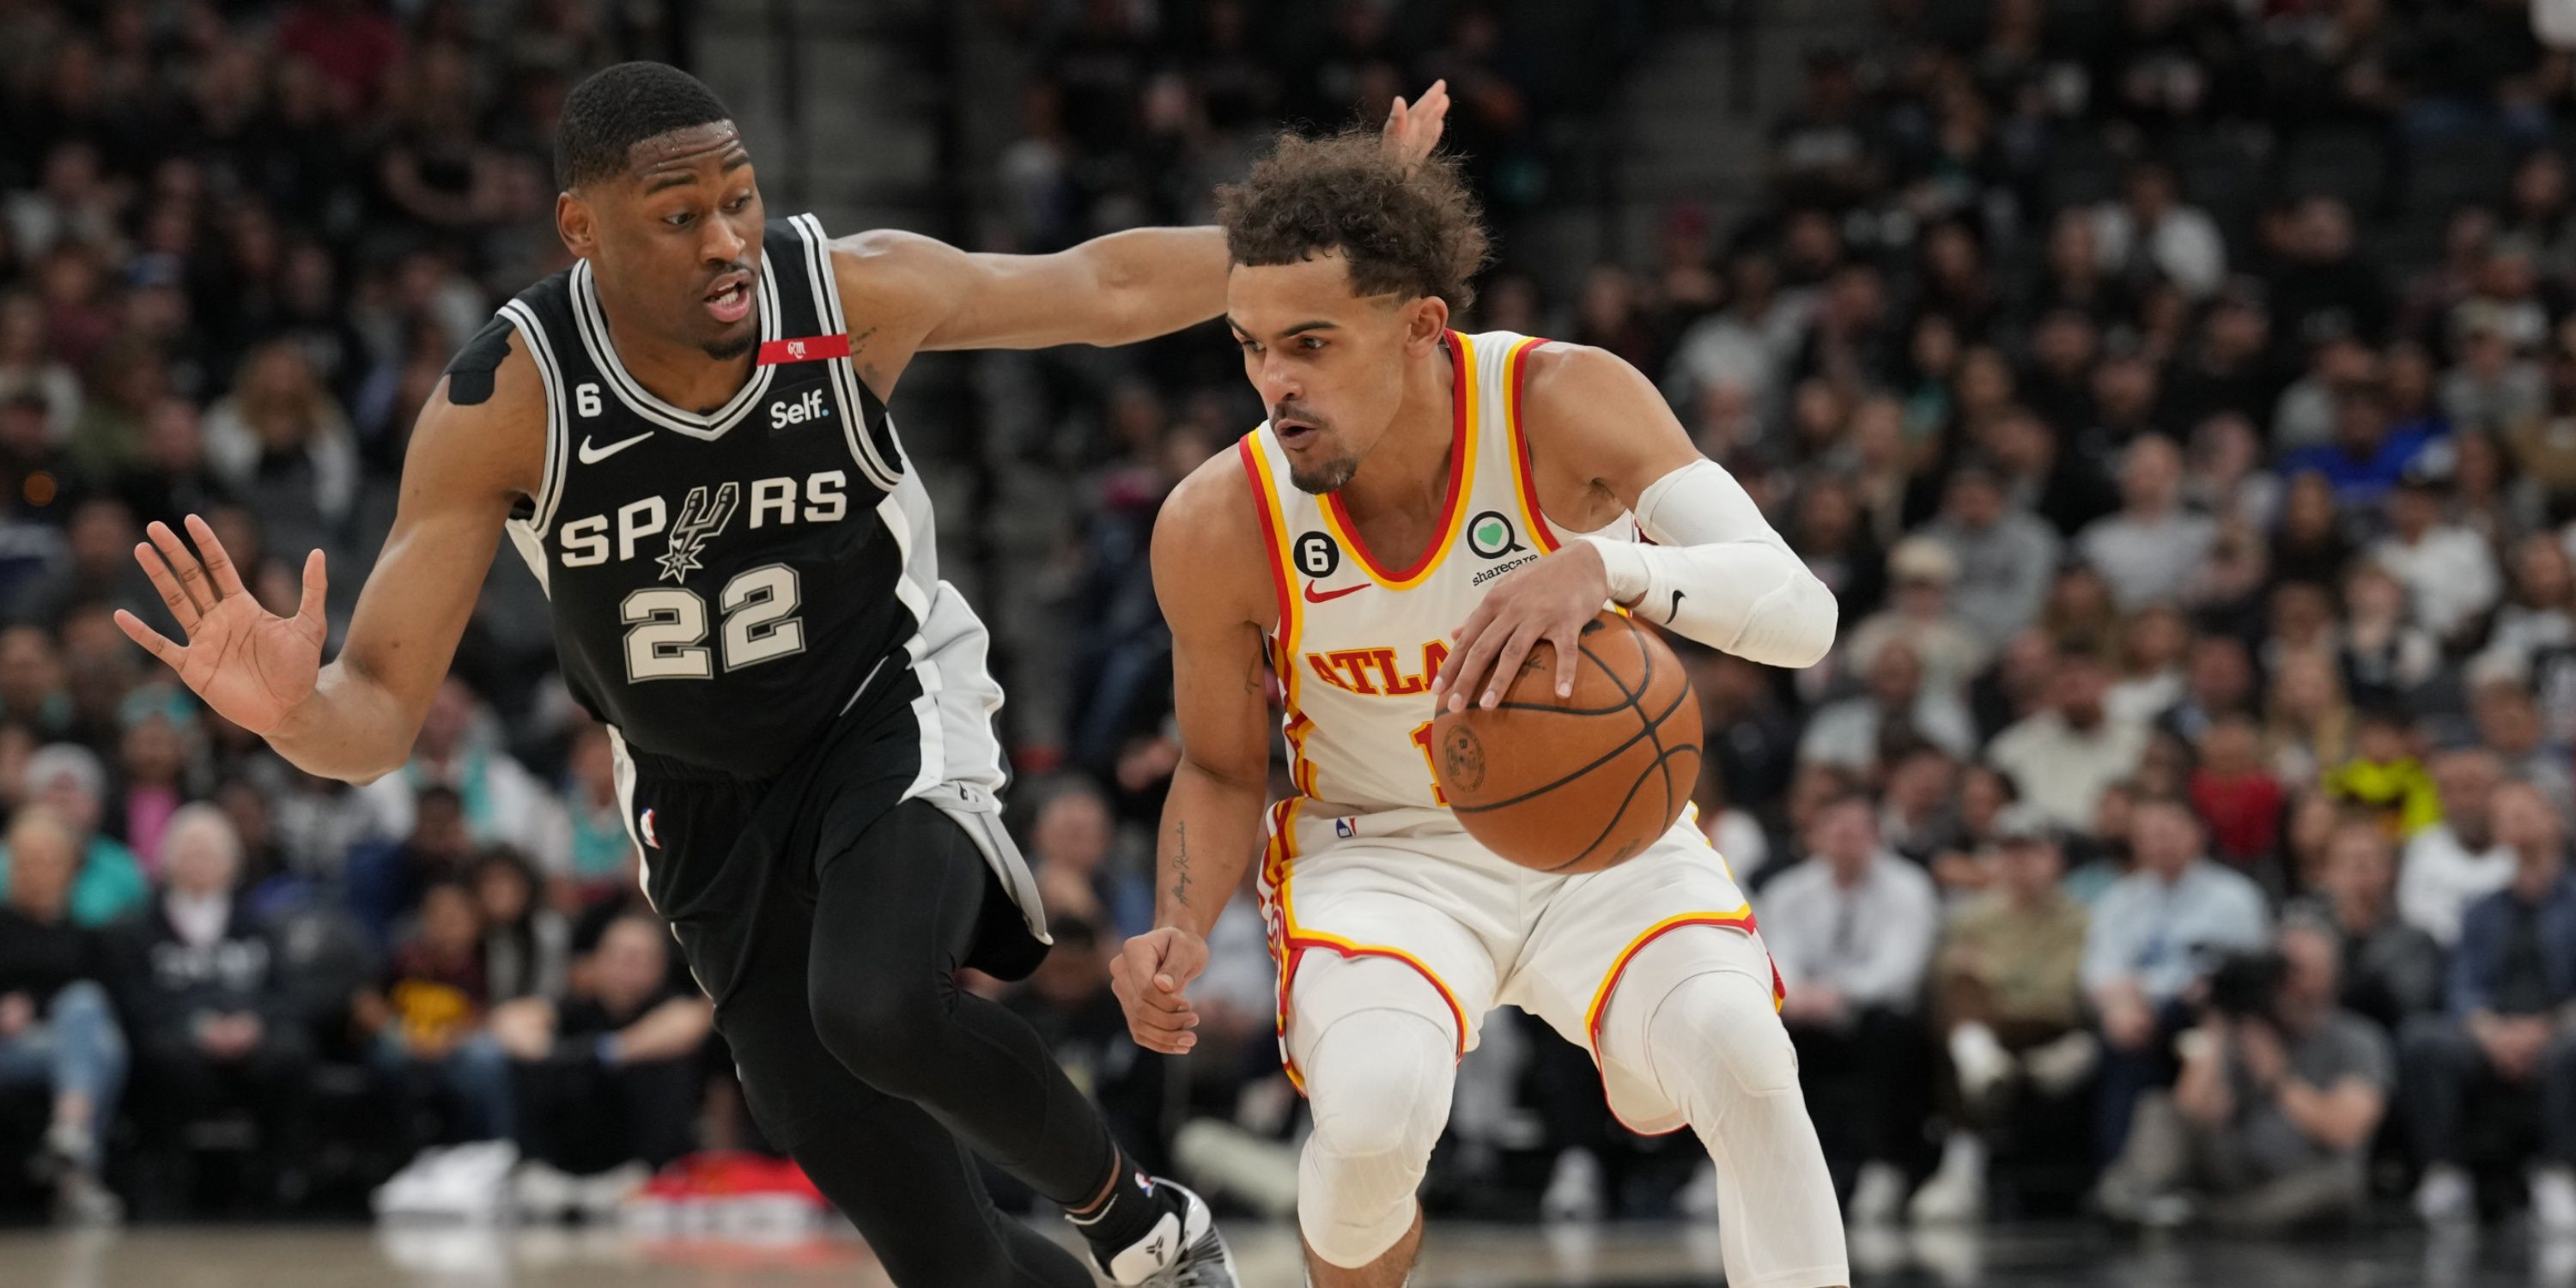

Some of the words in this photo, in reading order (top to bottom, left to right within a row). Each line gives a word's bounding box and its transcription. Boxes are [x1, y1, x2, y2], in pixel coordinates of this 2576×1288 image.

[575, 382, 603, 418] 6
[770, 388, 829, 429] Self.
[560, 470, 848, 585] SPURS
[1303, 538, 1329, 573] 6
[619, 562, 807, 685] 22
